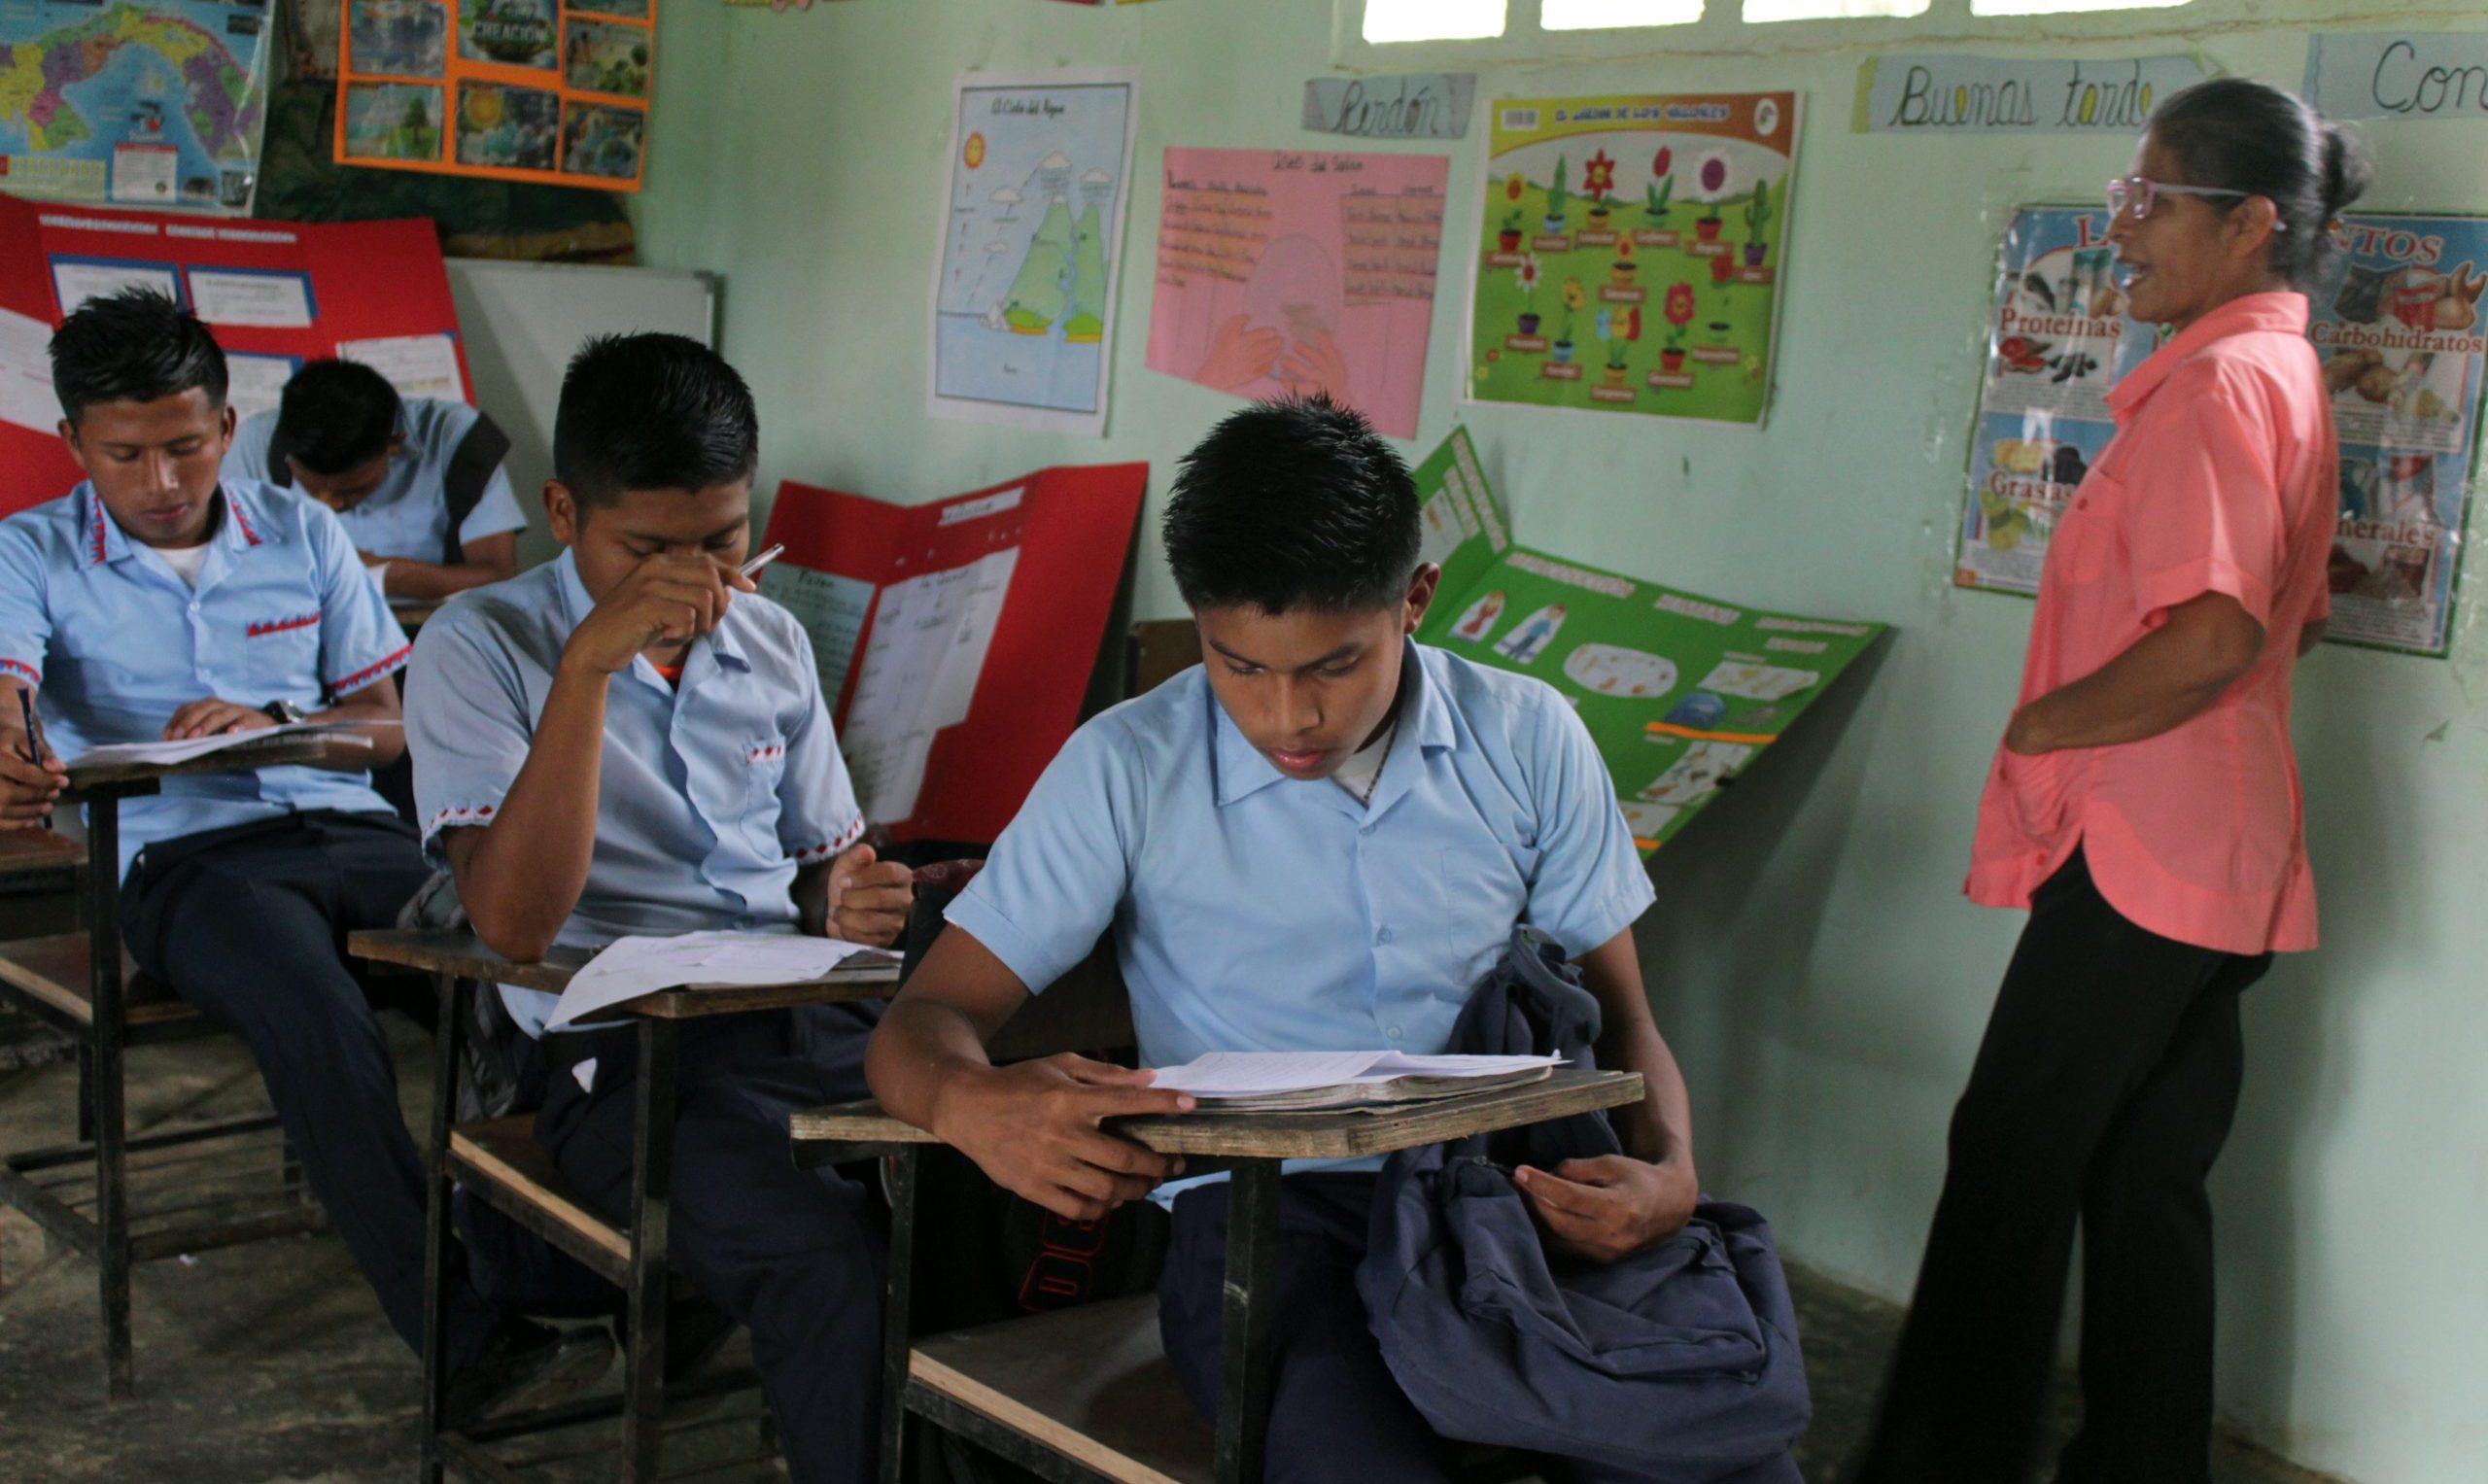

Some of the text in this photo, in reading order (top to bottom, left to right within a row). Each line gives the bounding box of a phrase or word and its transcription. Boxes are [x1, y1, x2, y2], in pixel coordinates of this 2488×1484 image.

[1332, 78, 1439, 135] Perdón
[1888, 59, 2154, 127] Buenas tarde
[2309, 321, 2483, 354] Carbohidratos
[2336, 518, 2436, 545] nerales
